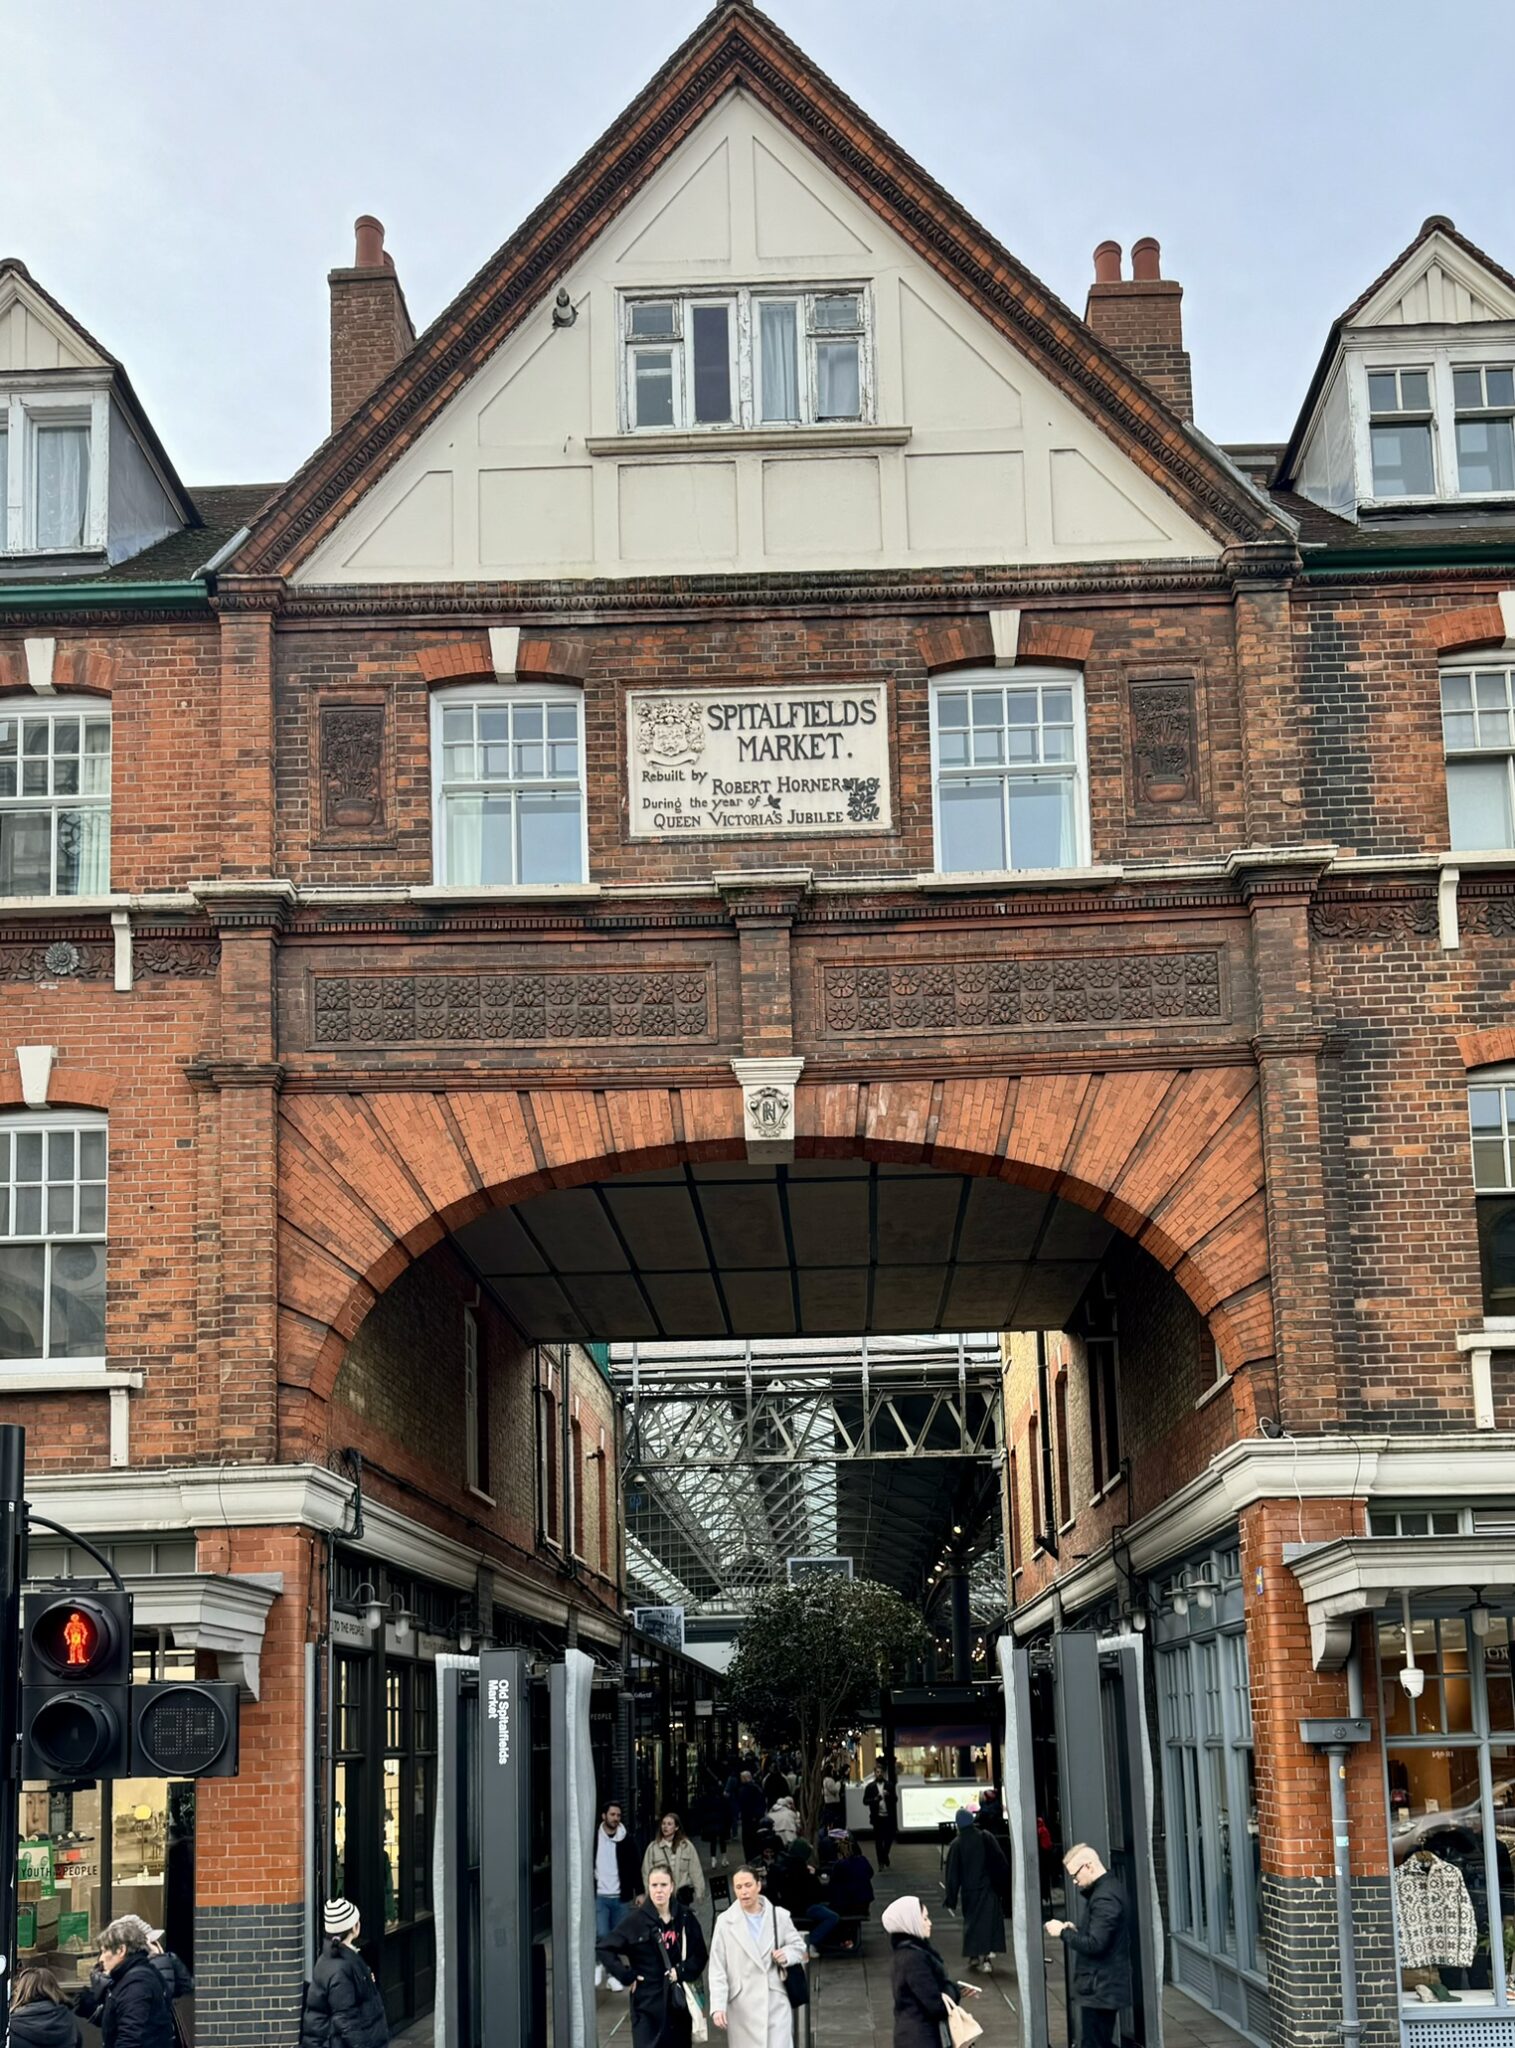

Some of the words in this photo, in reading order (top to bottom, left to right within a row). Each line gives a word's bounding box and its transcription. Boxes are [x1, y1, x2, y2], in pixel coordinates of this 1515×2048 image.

[707, 699, 877, 731] SPITALFIELDS
[737, 732, 853, 762] MARKET.
[642, 770, 686, 782] Rebuilt
[691, 769, 708, 783] by
[712, 779, 772, 796] ROBERT
[777, 776, 843, 794] HORNER
[642, 797, 682, 813] During
[690, 796, 708, 808] the
[712, 797, 743, 811] year
[747, 795, 761, 808] of
[654, 813, 701, 829] QUEEN
[706, 810, 783, 827] VICTORIA'S
[787, 809, 844, 825] JUBILEE
[350, 1623, 364, 1637] PEOPLE
[488, 1679, 499, 1719] Market
[498, 1679, 509, 1699] Old
[496, 1701, 509, 1765] Spitalfields
[21, 1867, 52, 1878] YOUTH
[63, 1865, 98, 1876] PEOPLE
